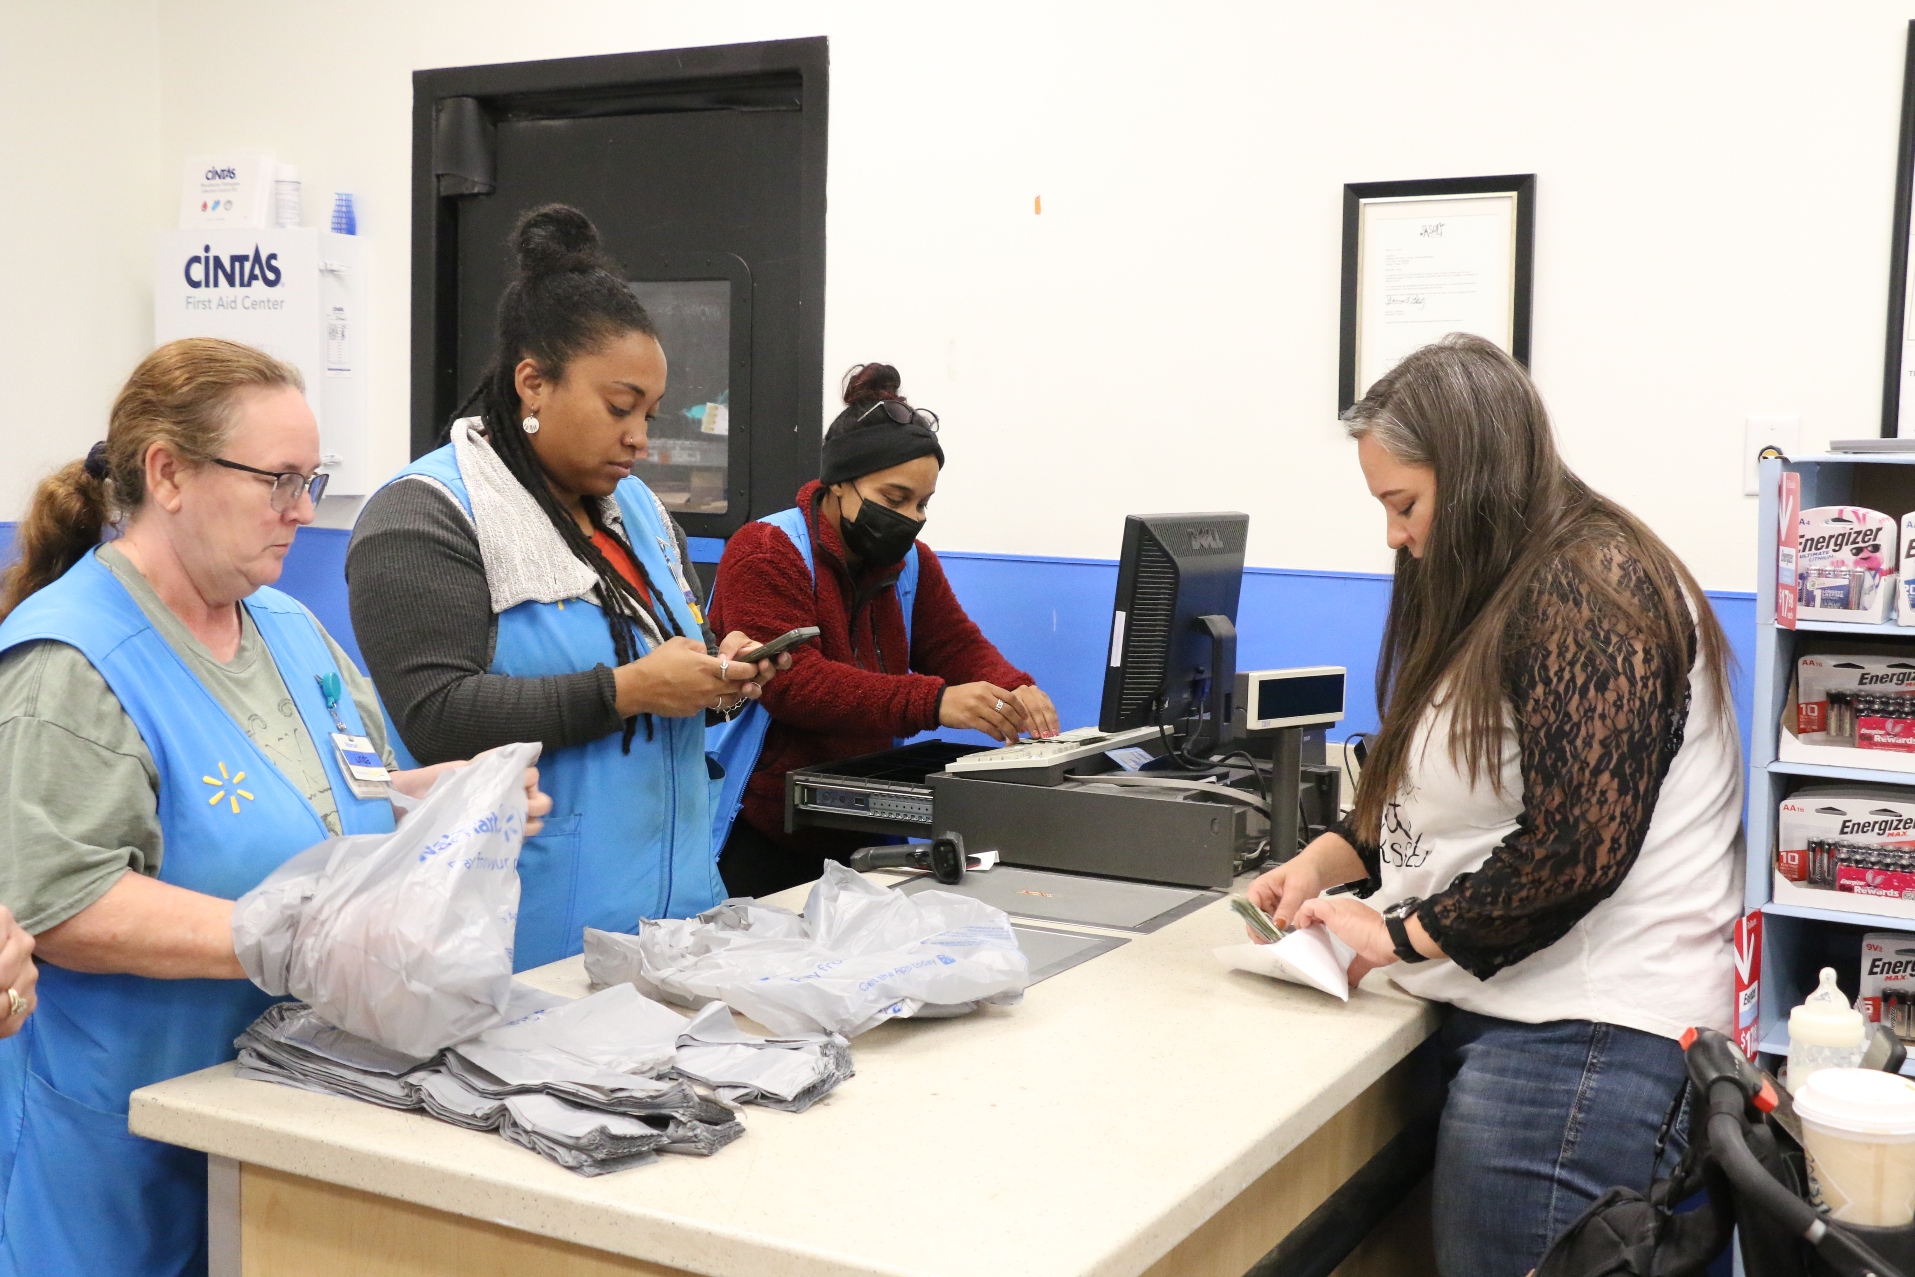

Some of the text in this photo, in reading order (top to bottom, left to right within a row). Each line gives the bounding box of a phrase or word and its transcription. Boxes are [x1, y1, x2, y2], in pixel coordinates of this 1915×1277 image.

[186, 296, 285, 310] First Aid Center
[1800, 704, 1818, 716] 10
[1839, 817, 1915, 836] Energize
[1781, 852, 1799, 864] 10
[1854, 885, 1900, 898] Rewards
[859, 958, 937, 992] Get the App today
